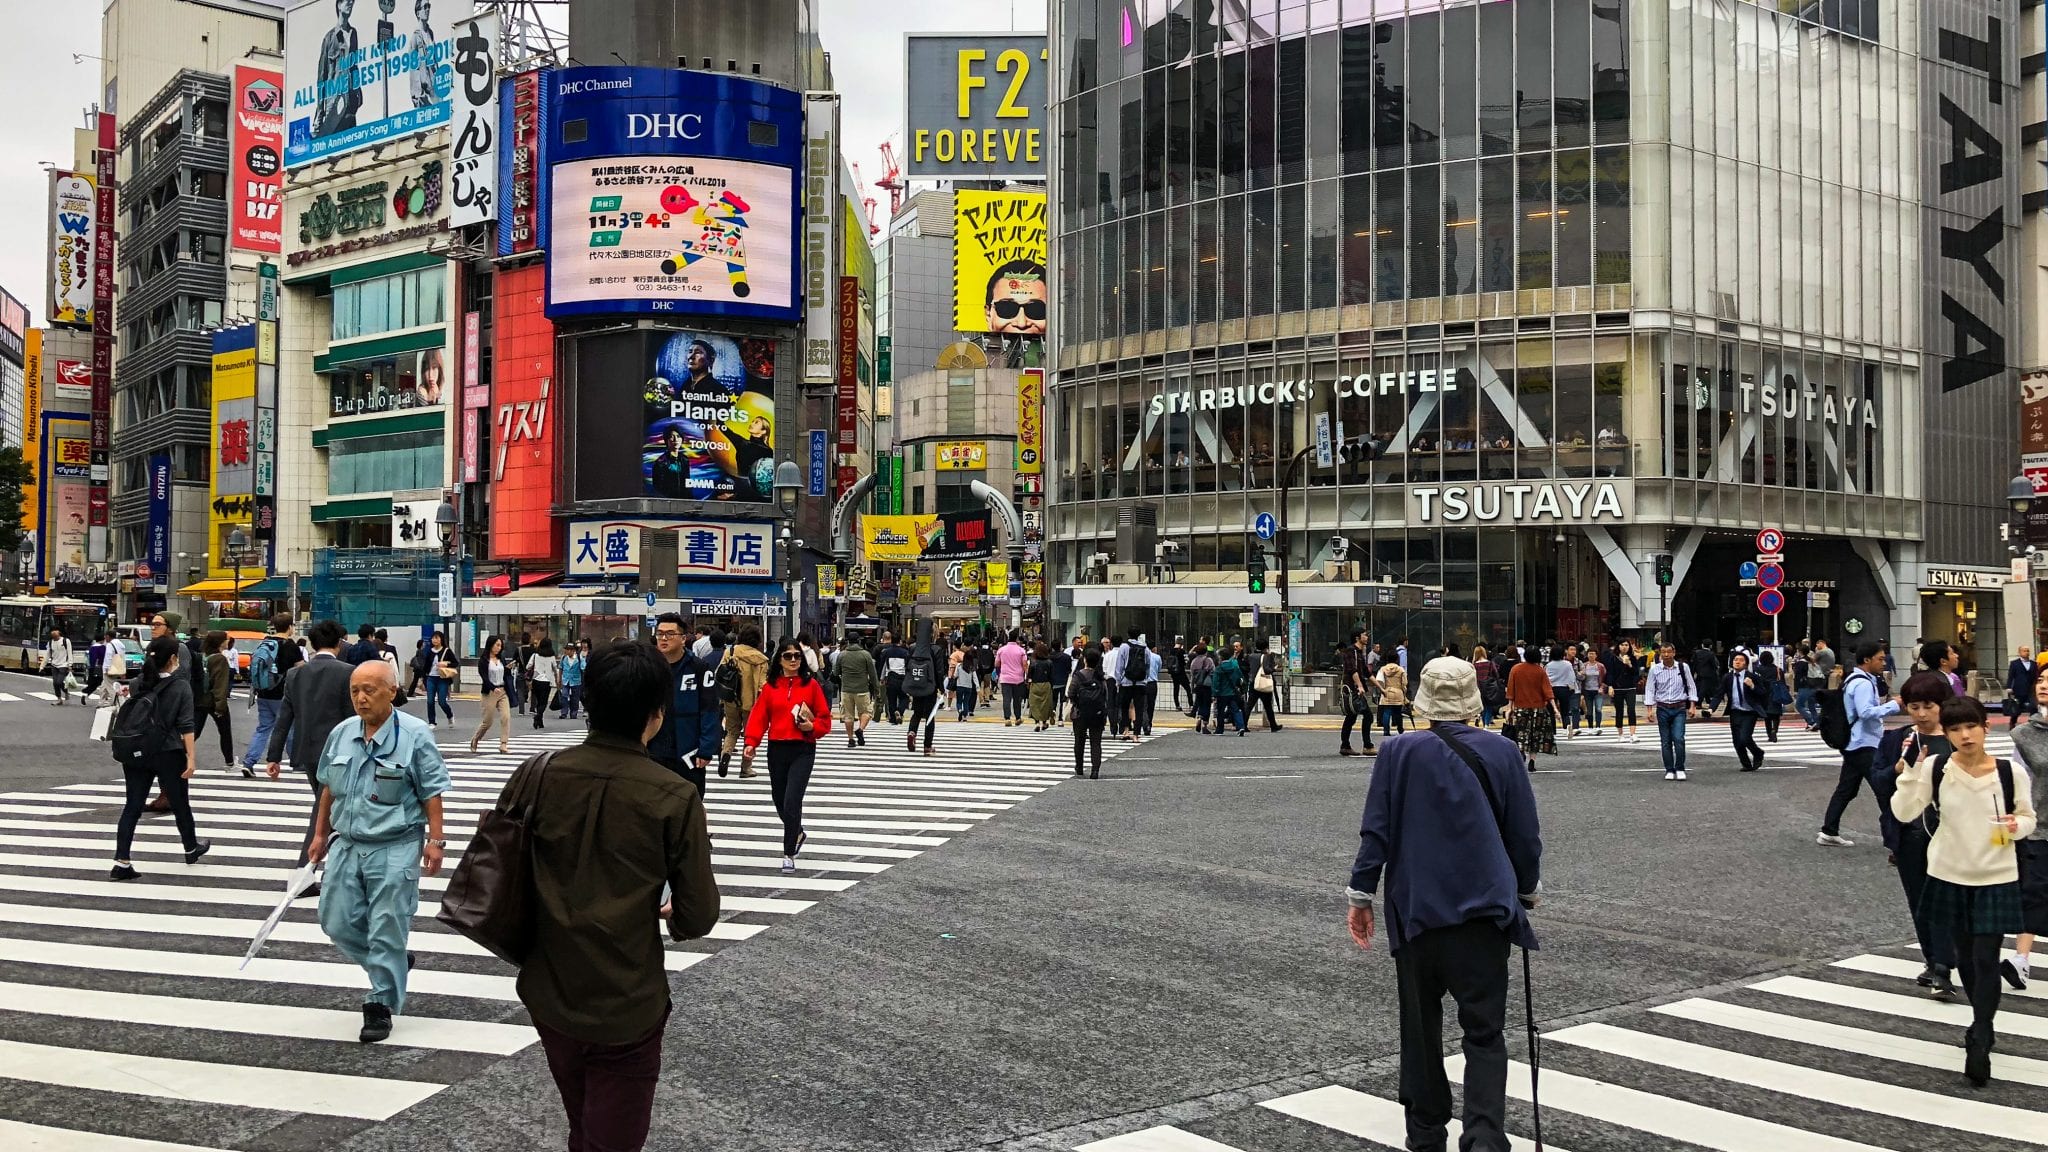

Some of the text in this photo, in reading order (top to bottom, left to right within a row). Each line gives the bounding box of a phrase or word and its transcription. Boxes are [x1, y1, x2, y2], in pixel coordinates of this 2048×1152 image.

[294, 40, 452, 109] ALL TIME BEST 1998-201
[559, 77, 632, 95] DHC Channel
[453, 21, 494, 217] もんじゃ
[627, 113, 702, 140] DHC
[311, 141, 327, 153] 20th
[328, 130, 368, 147] Anniversary
[370, 125, 388, 138] Song
[915, 129, 1040, 162] FOREVE
[247, 181, 279, 200] B1F
[246, 200, 279, 220] B2F
[809, 130, 830, 309] Taisei neon
[636, 284, 703, 293] (03) 3463-1142
[652, 301, 674, 310] DHC
[215, 361, 246, 373] Matsumoto
[840, 281, 855, 444] クスリのことなら 三千里
[27, 354, 38, 442] Matsumoto KiYoshi
[335, 390, 411, 415] Euphoria
[682, 389, 729, 403] teamLab
[1151, 368, 1457, 415] STARBUCKS COFFEE
[670, 400, 749, 423] Planets
[1740, 382, 1878, 429] TSUTAYA
[495, 377, 550, 481] クスリ
[695, 423, 728, 431] TOKYO
[63, 439, 89, 463] 薬
[220, 417, 250, 467] 薬
[690, 439, 731, 452] TOYOSU
[1022, 451, 1035, 461] 4F
[158, 465, 166, 500] MIZUHO
[685, 478, 734, 491] DMM.com
[2030, 470, 2048, 491] 本
[1412, 482, 1624, 522] TSUTAYA
[154, 525, 163, 562] みずほ銀行
[576, 528, 763, 566] 大盛書店
[1798, 580, 1836, 588] COFFEE
[1928, 570, 1979, 587] TSUTAYA
